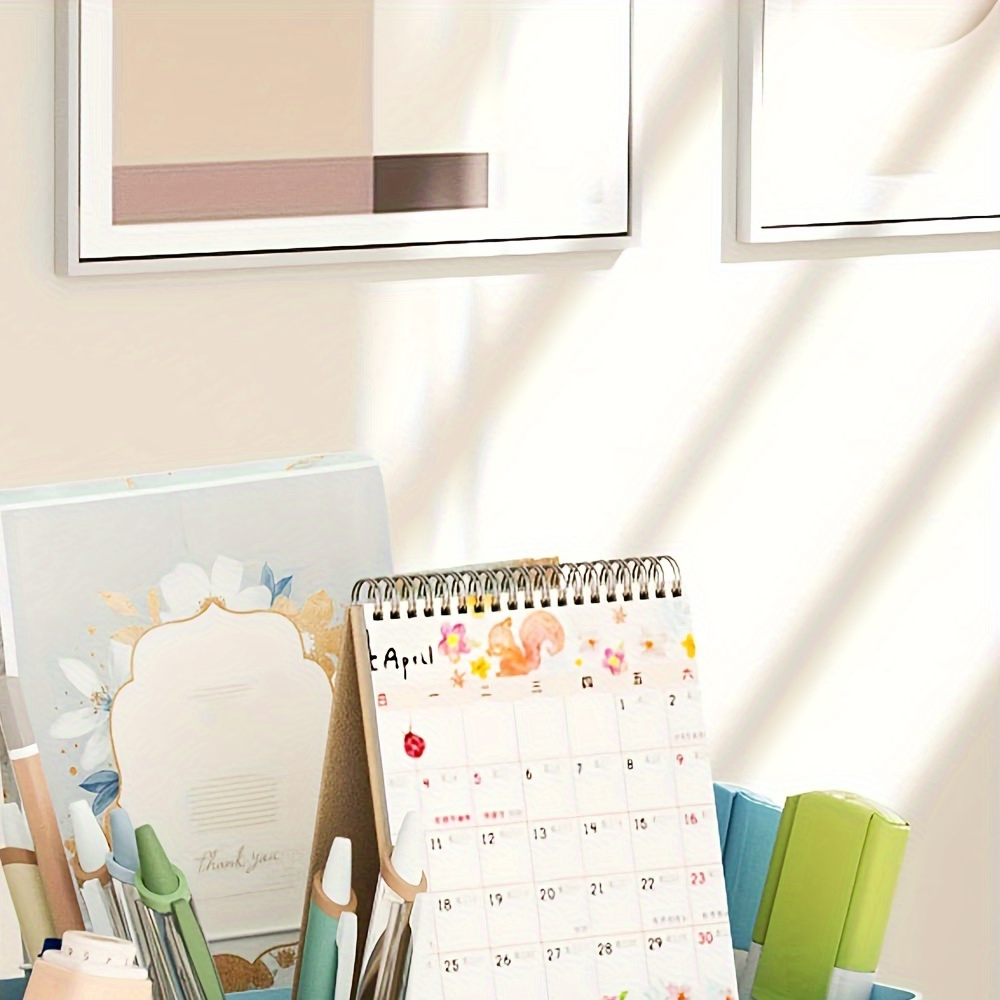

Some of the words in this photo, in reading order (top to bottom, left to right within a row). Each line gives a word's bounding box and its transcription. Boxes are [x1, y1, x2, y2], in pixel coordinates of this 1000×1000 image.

[383, 645, 434, 681] April
[531, 680, 543, 694] 三
[430, 837, 442, 851] 11
[482, 832, 495, 845] 12
[533, 827, 547, 840] 13
[583, 822, 597, 835] 14
[634, 817, 647, 830] 15
[684, 813, 698, 825] 16
[438, 898, 452, 912] 18
[489, 893, 503, 907] 19
[539, 887, 556, 901] 20
[590, 882, 604, 896] 21
[641, 877, 655, 891] 22
[691, 871, 706, 886] 23
[444, 959, 459, 973] 25
[496, 954, 512, 967] 26
[546, 947, 561, 962] 27
[597, 942, 613, 956] 28
[647, 937, 663, 951] 29
[698, 930, 714, 946] 30
